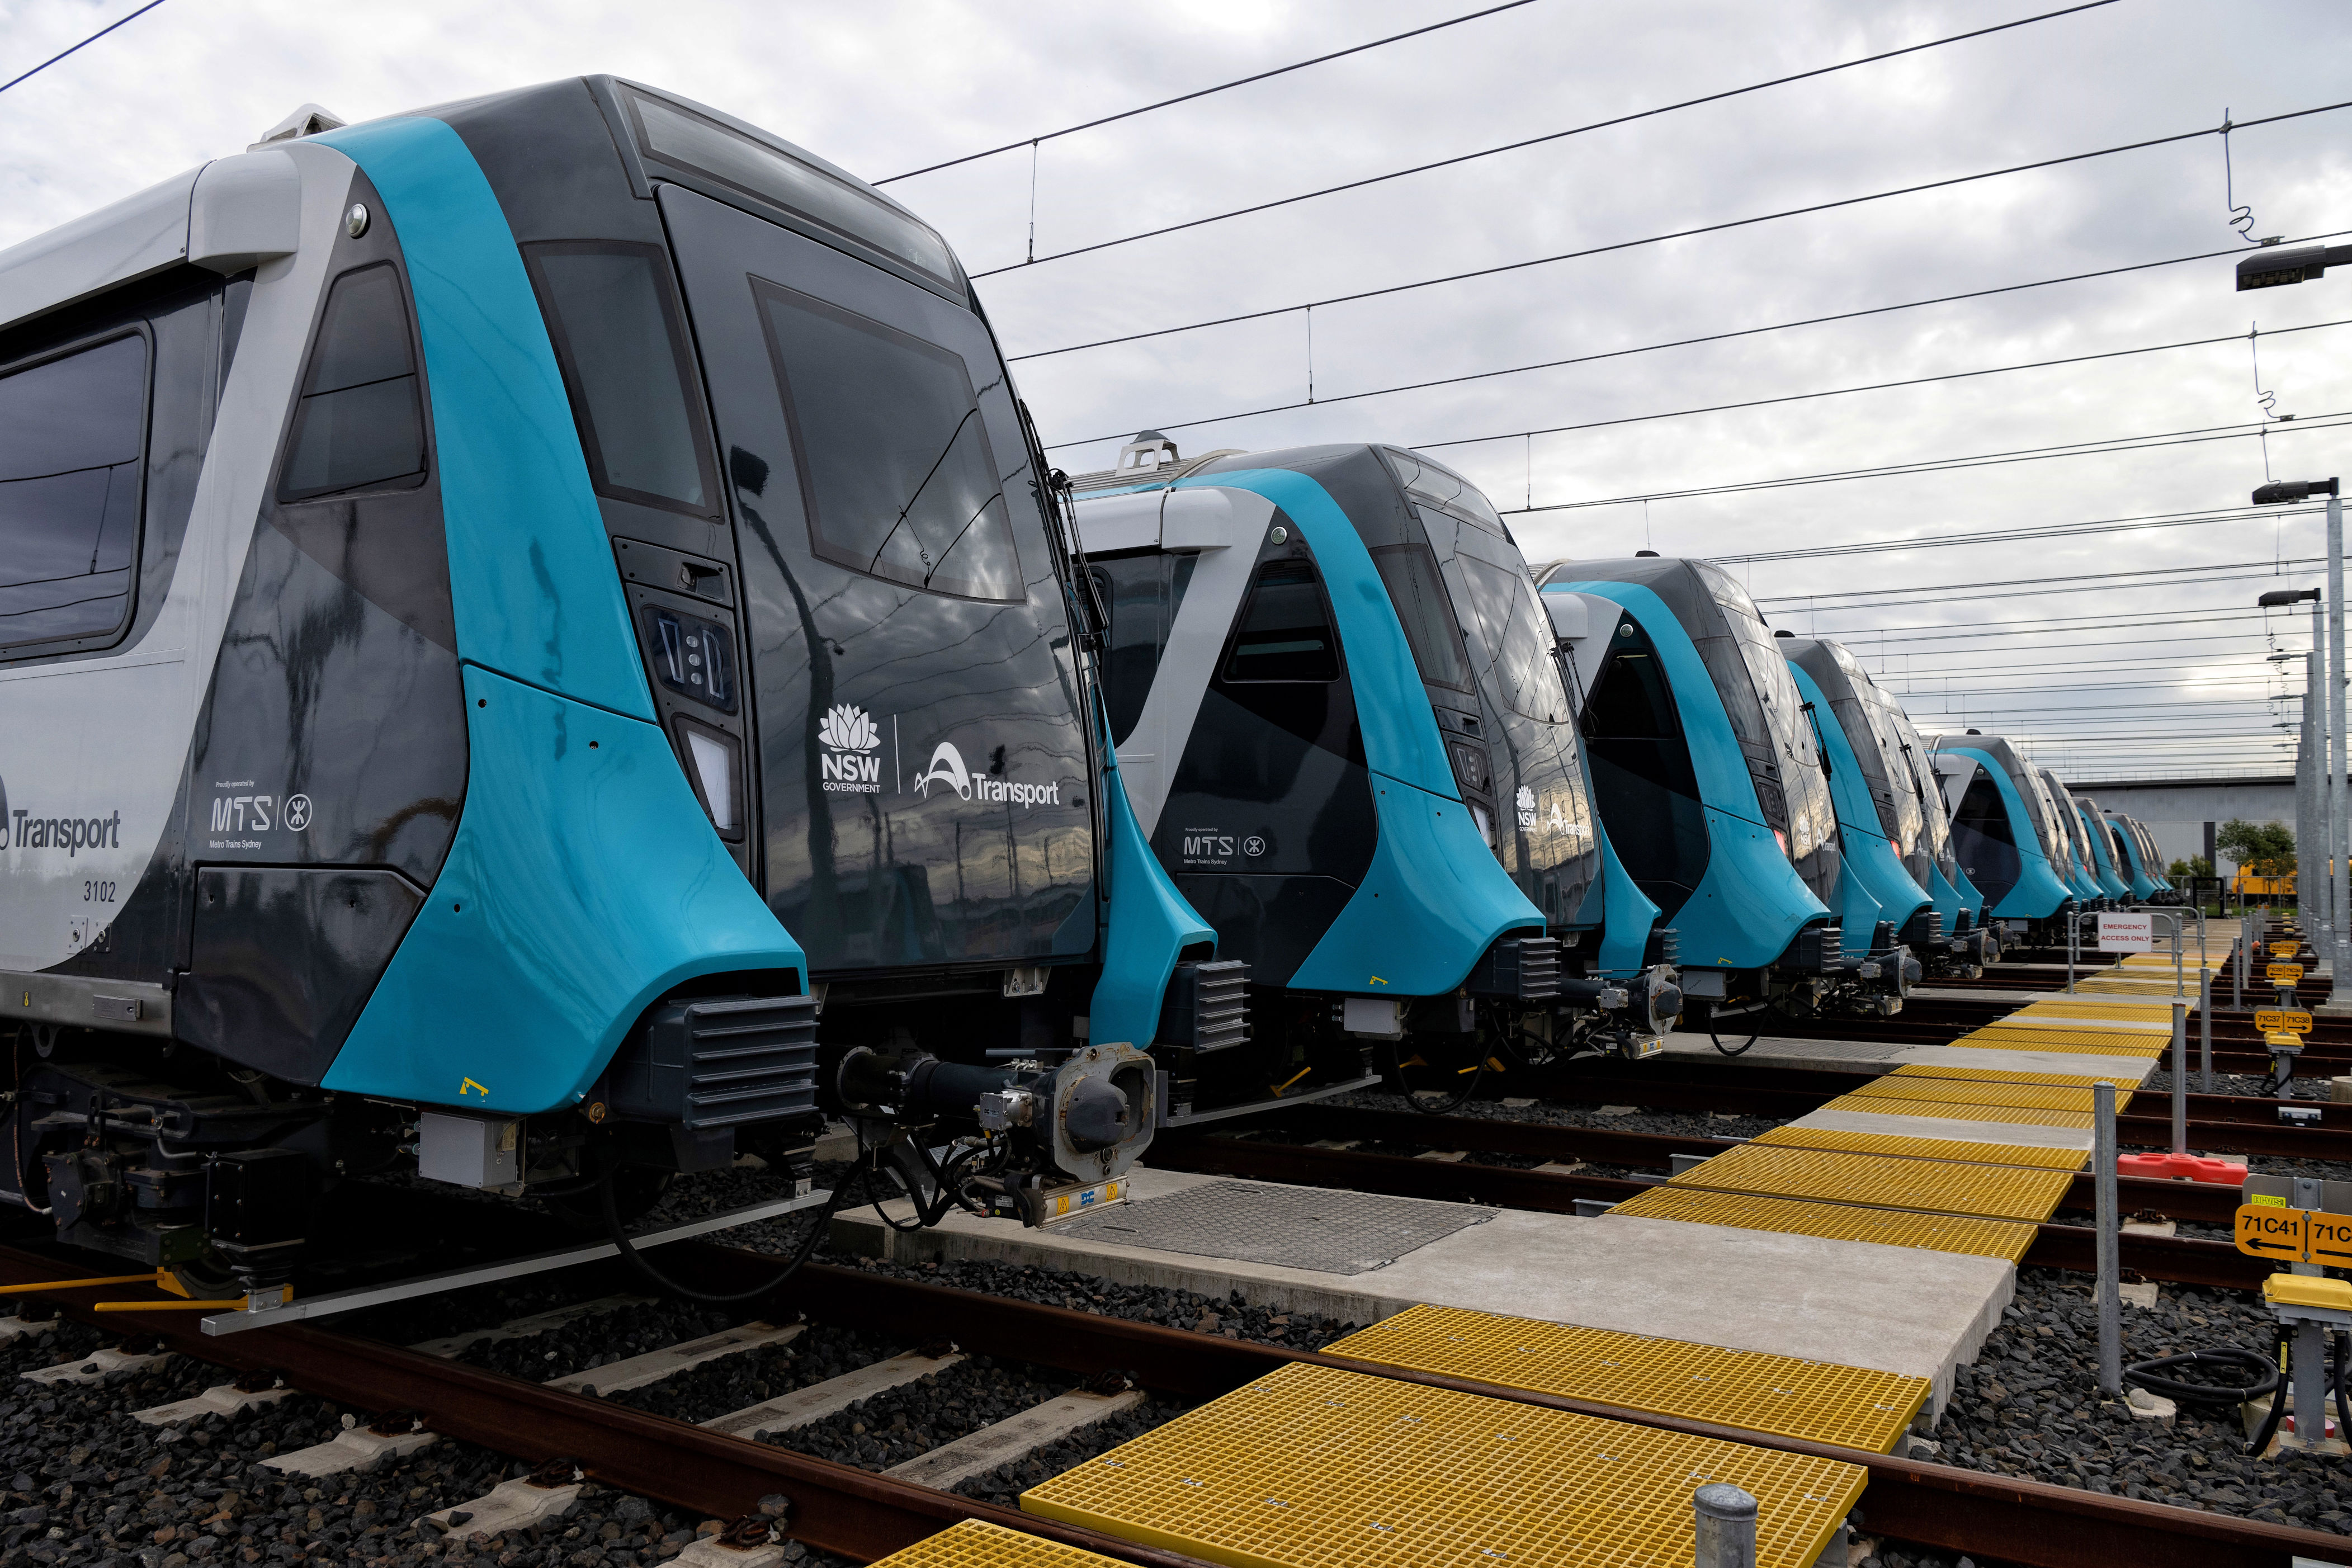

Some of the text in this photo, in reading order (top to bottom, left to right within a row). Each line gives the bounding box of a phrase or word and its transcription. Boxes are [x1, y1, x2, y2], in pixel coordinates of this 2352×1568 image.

[821, 753, 880, 782] NSW
[231, 780, 248, 788] operated
[823, 782, 881, 794] GOVERNMENT
[971, 773, 1060, 809] Transport
[211, 795, 272, 832] MTS
[1518, 811, 1537, 826] NSW
[13, 810, 121, 858] Transport
[1564, 819, 1590, 839] Transport
[209, 839, 262, 849] Metro Trains Sydney
[1184, 836, 1234, 856] MTS
[84, 880, 116, 903] 3102
[2253, 1196, 2282, 1206] HI-VIS
[2242, 1215, 2297, 1236] 71C41
